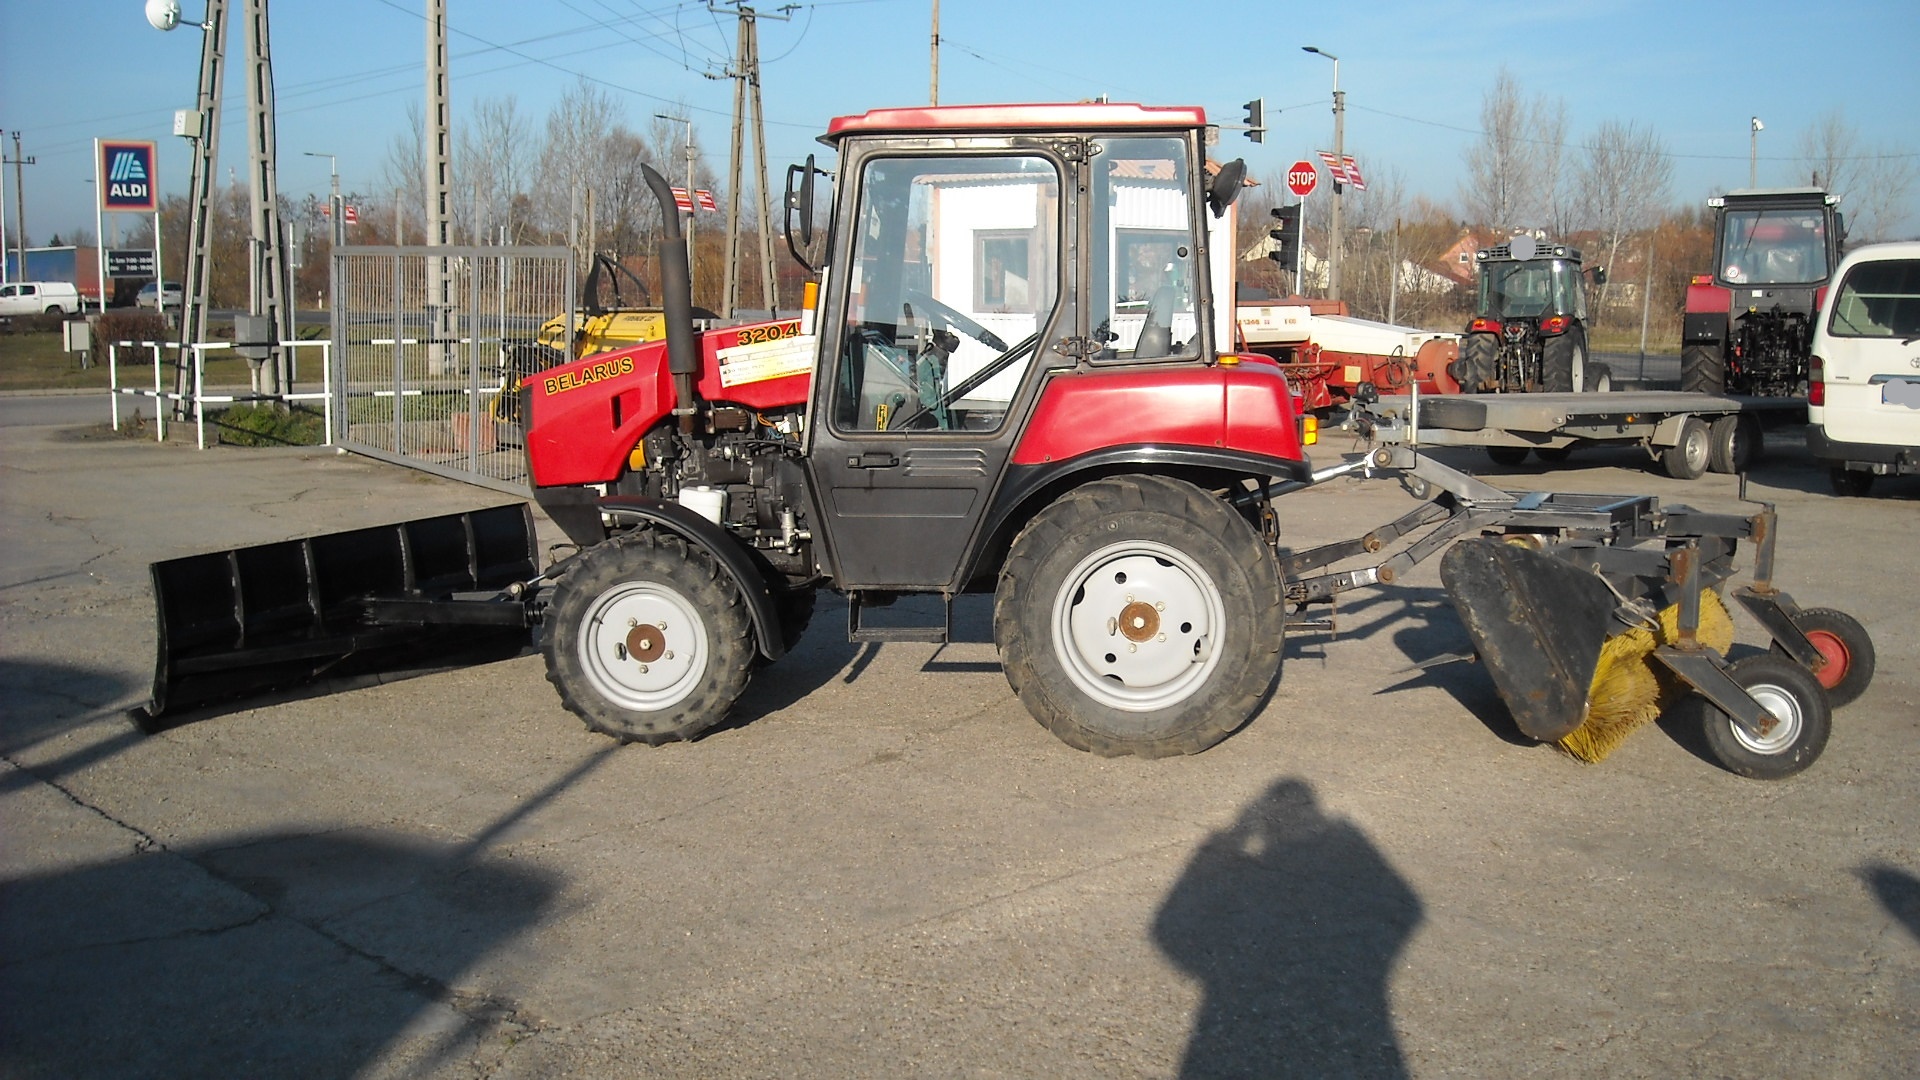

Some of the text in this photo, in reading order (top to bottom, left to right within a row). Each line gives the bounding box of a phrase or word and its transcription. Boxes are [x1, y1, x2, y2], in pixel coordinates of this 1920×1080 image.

[1289, 171, 1315, 186] STOP
[110, 183, 147, 197] ALDI
[737, 322, 799, 346] 320.4
[544, 357, 634, 396] BELARUS
